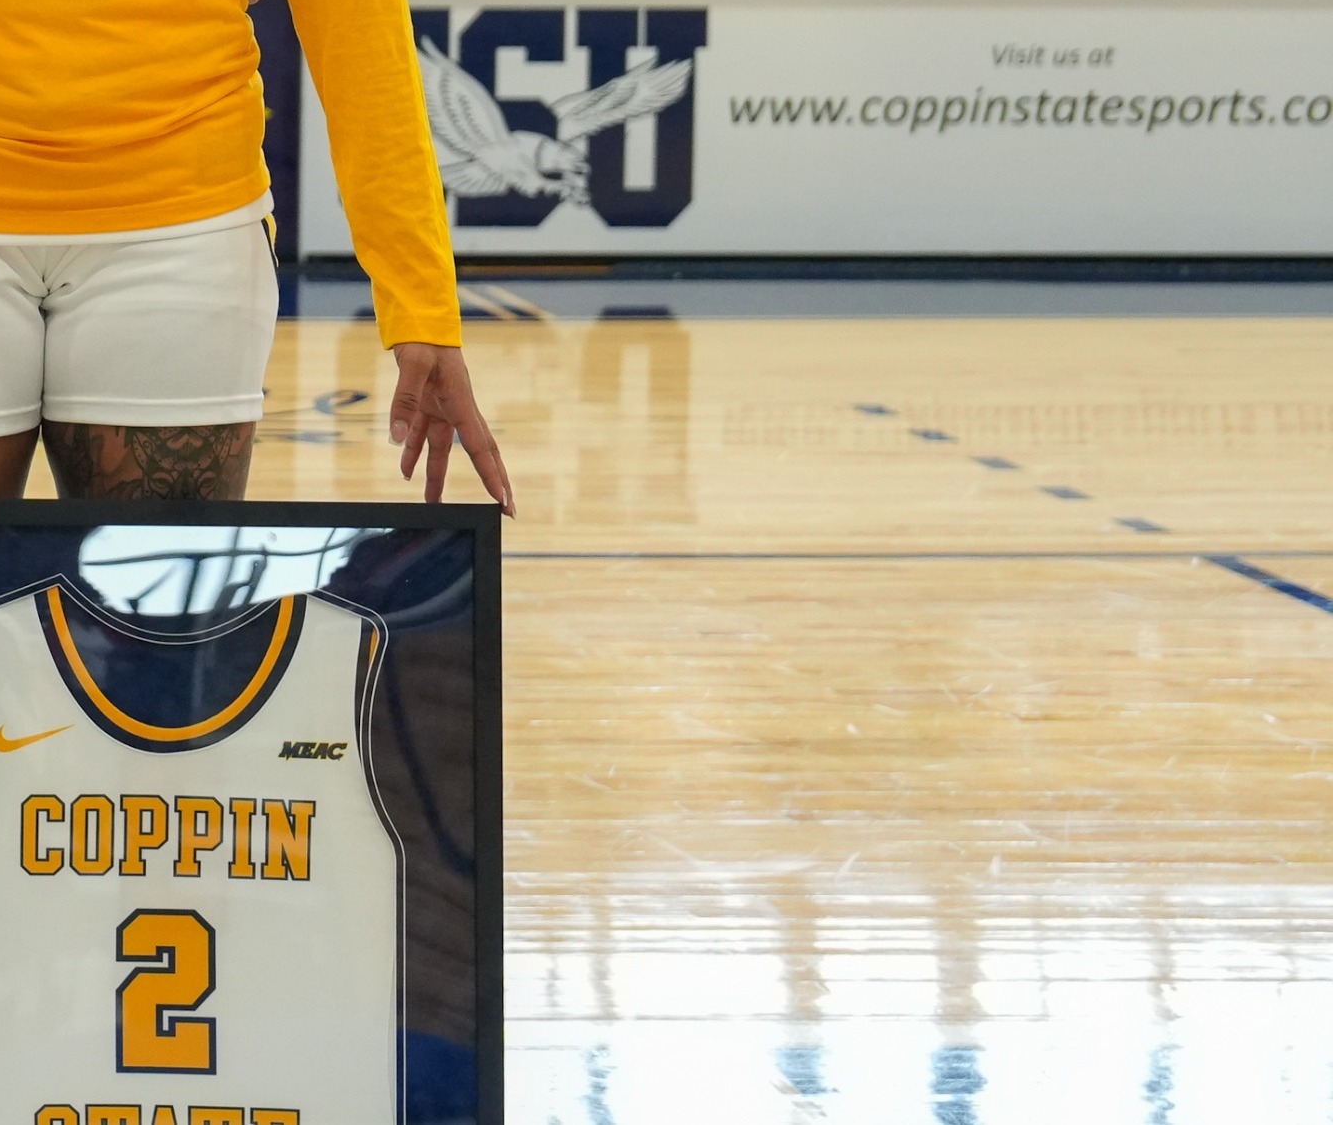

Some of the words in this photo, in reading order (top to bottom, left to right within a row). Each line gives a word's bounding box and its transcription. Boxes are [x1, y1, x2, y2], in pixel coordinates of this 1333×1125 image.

[991, 42, 1045, 68] Visit
[1052, 47, 1083, 68] us
[1087, 45, 1117, 68] at
[411, 8, 708, 228] SU
[277, 741, 348, 762] MEAC
[20, 793, 317, 882] COPPIN
[115, 907, 217, 1075] 2
